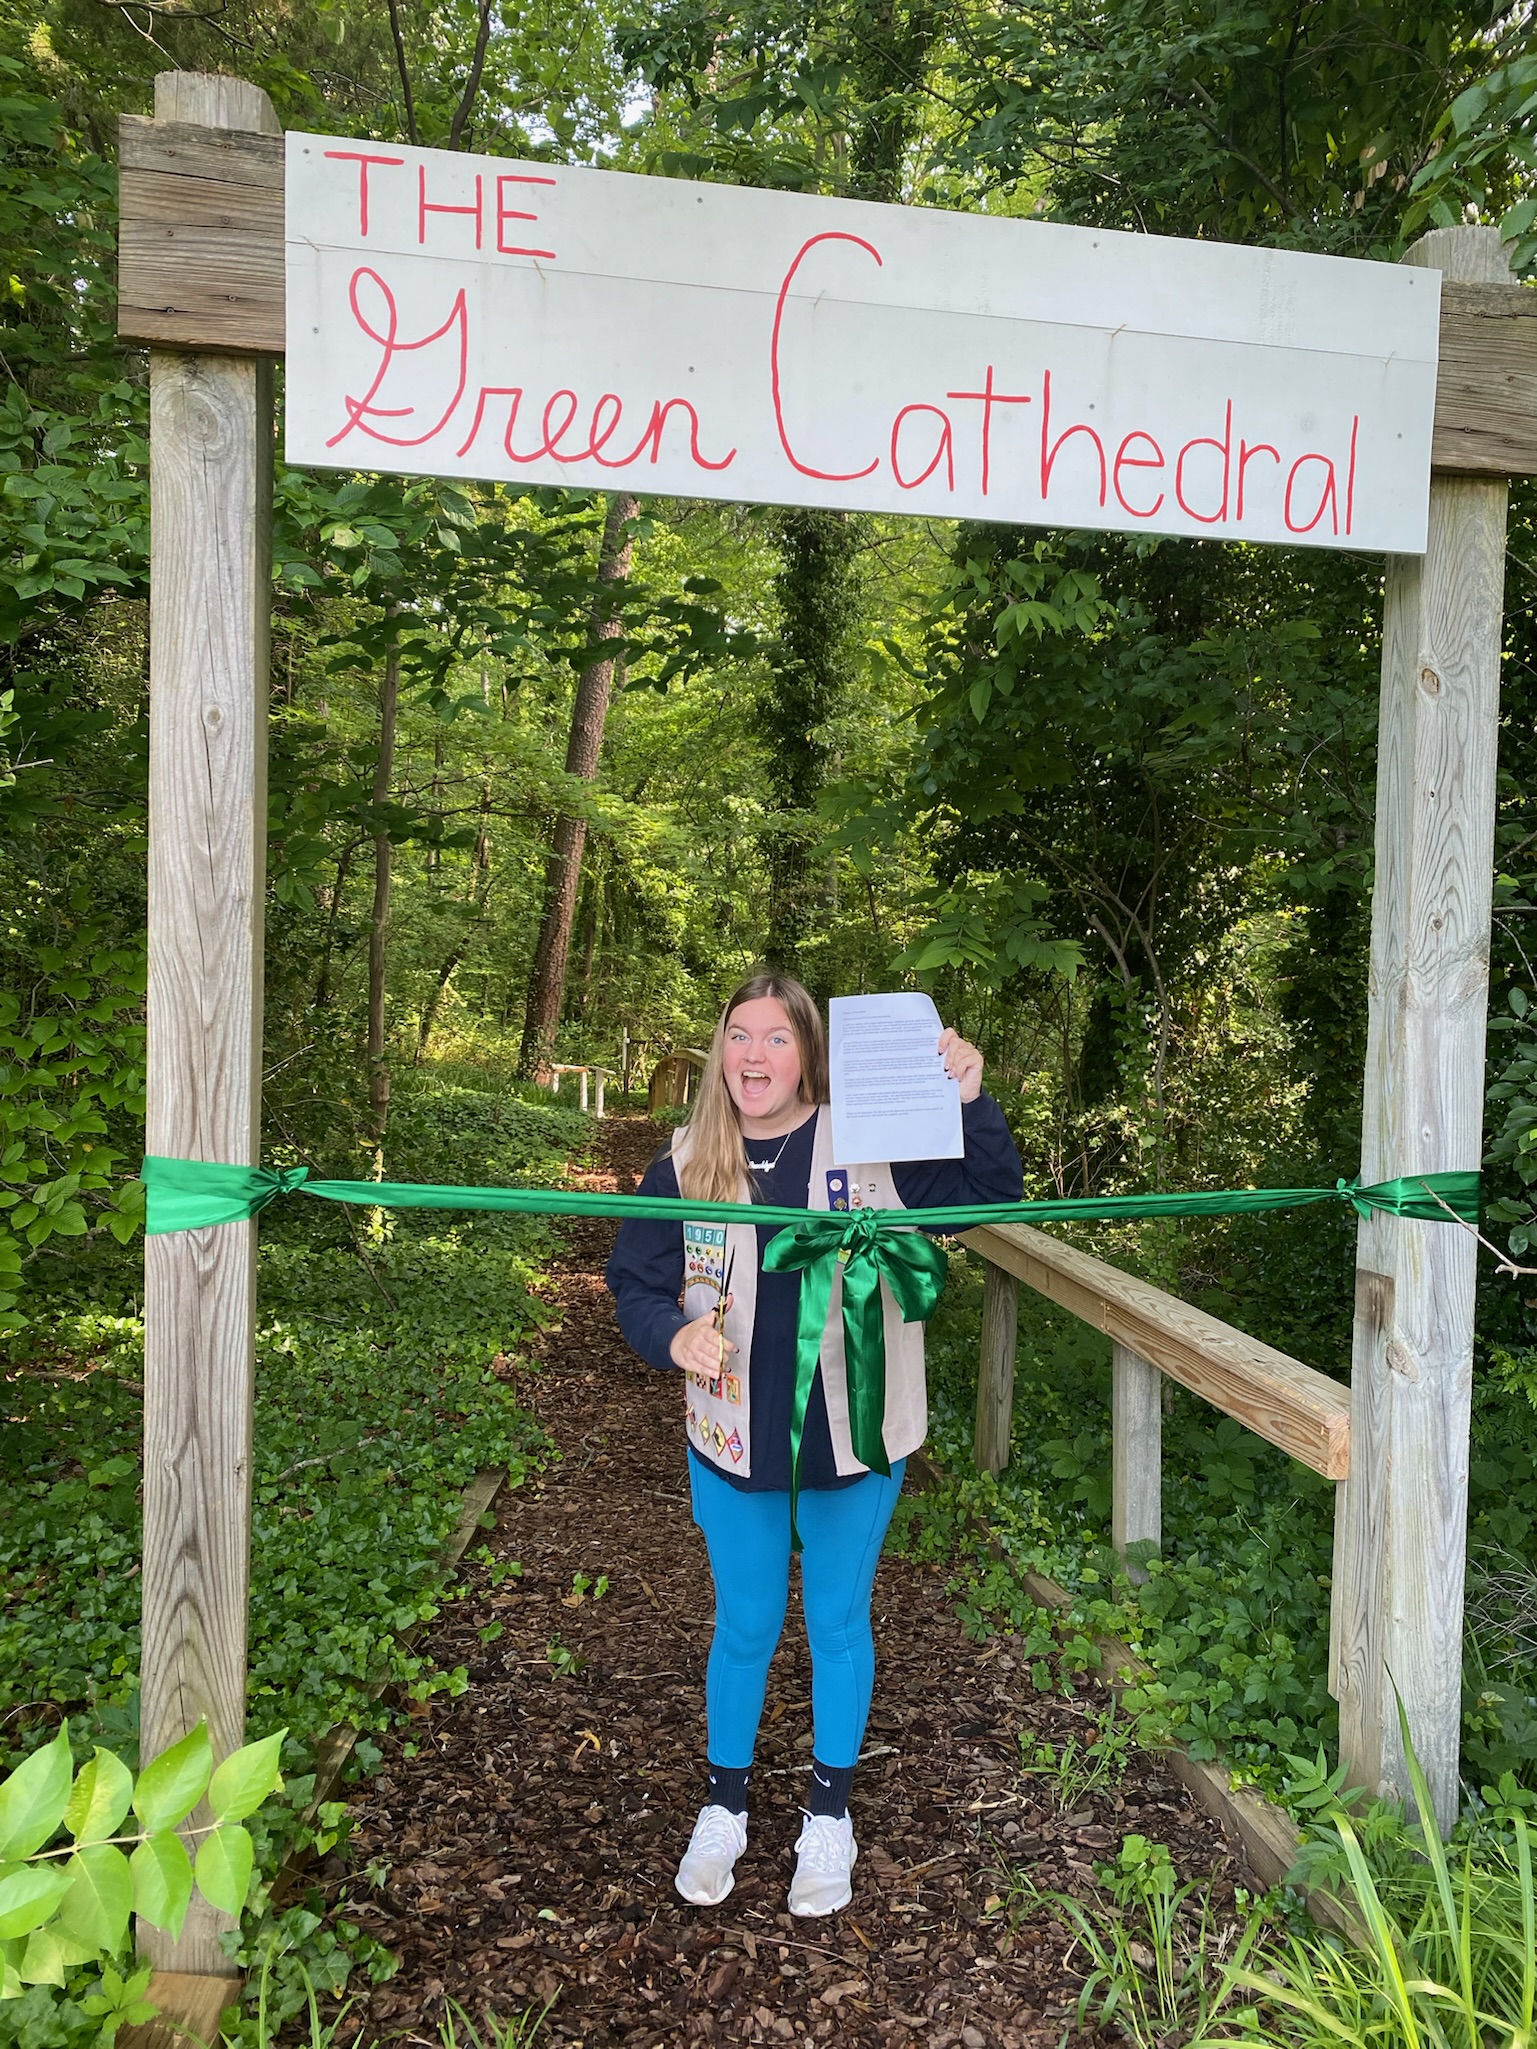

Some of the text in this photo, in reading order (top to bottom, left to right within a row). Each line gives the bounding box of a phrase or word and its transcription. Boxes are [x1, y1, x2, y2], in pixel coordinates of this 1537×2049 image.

[324, 151, 556, 258] THE
[326, 231, 1358, 535] Green Cathedral
[687, 1227, 723, 1244] 1950
